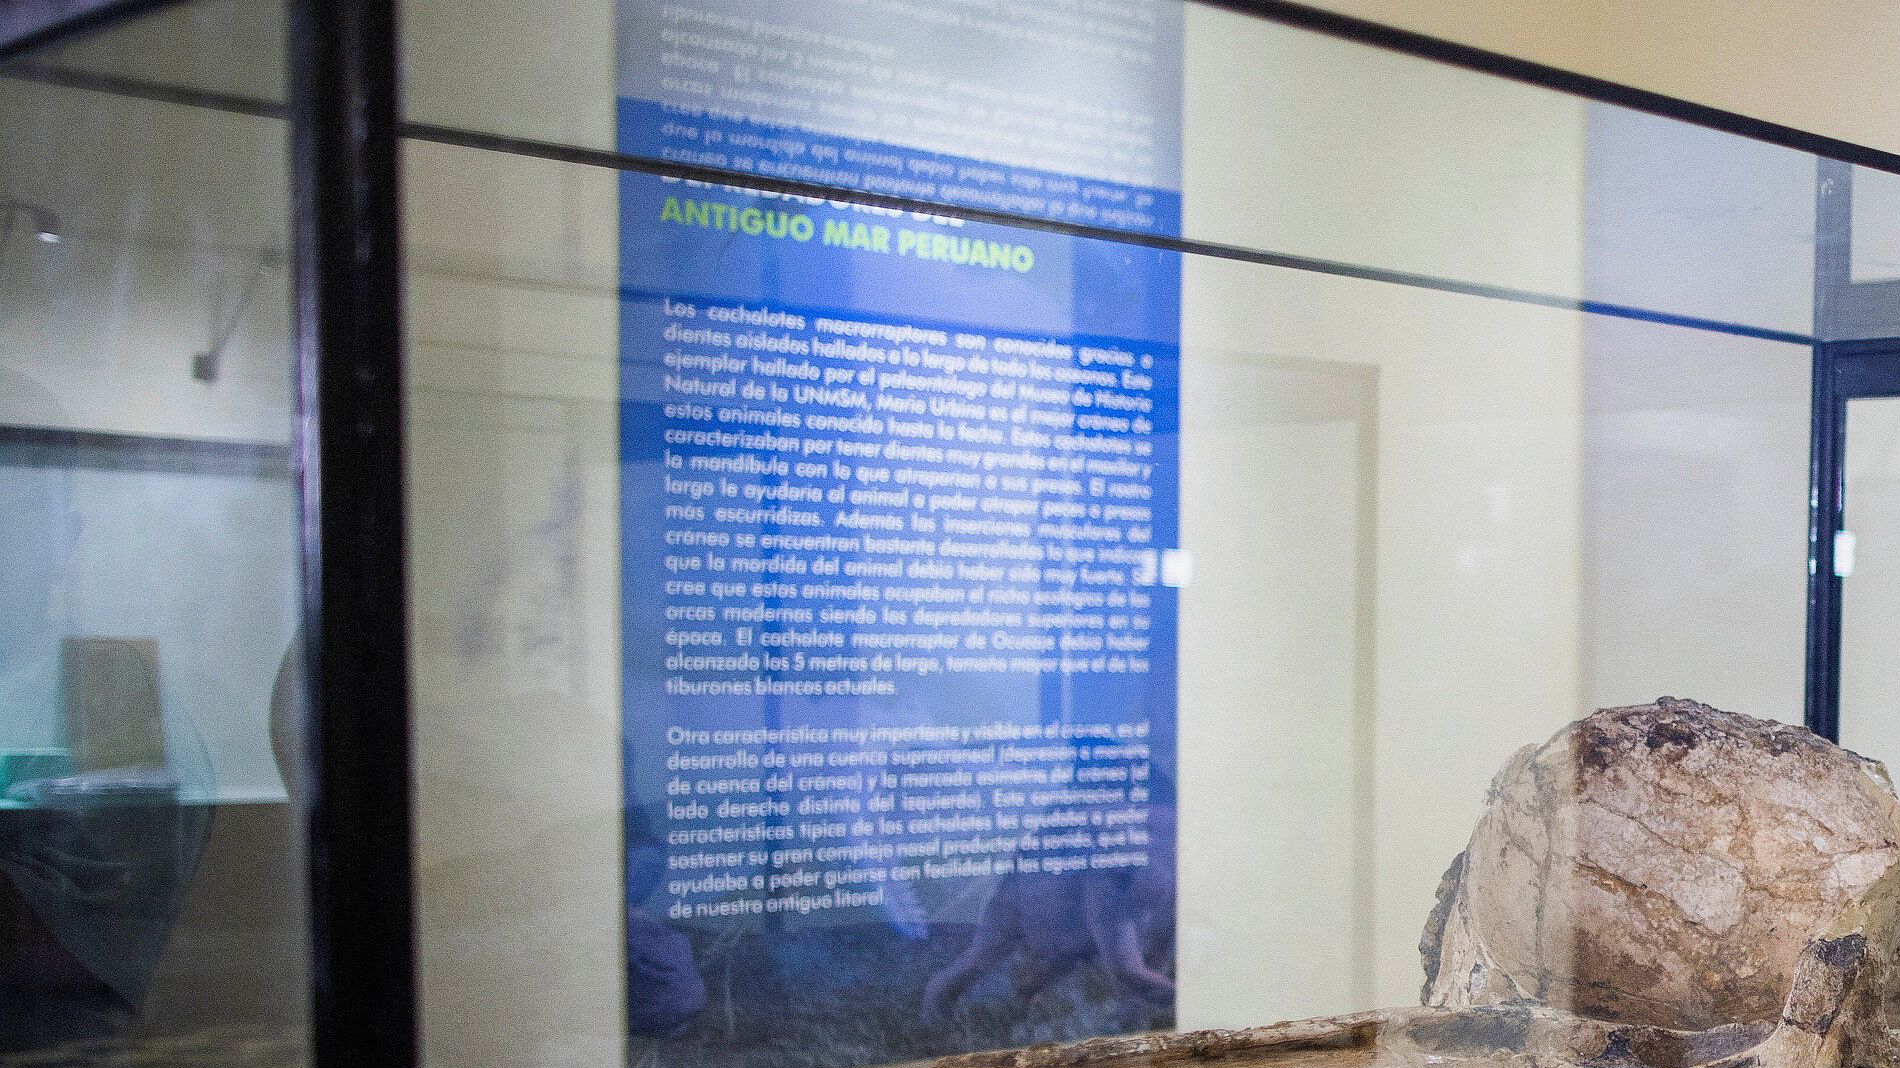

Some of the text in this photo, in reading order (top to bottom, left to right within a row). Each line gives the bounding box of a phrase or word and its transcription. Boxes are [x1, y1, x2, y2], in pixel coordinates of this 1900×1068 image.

[660, 197, 814, 242] ANTIGUO
[823, 219, 891, 254] MAR
[897, 229, 1034, 274] PERUANO
[664, 298, 696, 319] Los
[707, 306, 806, 331] cachalotes
[815, 318, 947, 346] macrorraptores
[664, 323, 732, 347] dientes
[736, 332, 809, 355] aislados
[813, 337, 885, 362] hallados
[664, 349, 747, 375] ejemplar
[752, 355, 820, 380] hallado
[824, 366, 855, 386] por
[858, 366, 874, 385] el
[664, 371, 735, 396] Natural
[742, 378, 765, 398] de
[771, 381, 788, 400] la
[664, 401, 712, 420] estos
[718, 405, 801, 427] animales
[806, 414, 883, 434] conocido
[888, 416, 933, 438] hasta
[664, 428, 799, 451] caracterizaban
[803, 437, 834, 456] por
[836, 436, 881, 457] tener
[665, 449, 682, 468] la
[796, 461, 827, 478] con
[833, 460, 851, 479] la
[856, 465, 889, 485] que
[665, 474, 714, 499] largo
[720, 477, 738, 497] le
[827, 484, 845, 503] al
[850, 487, 908, 506] animal
[735, 533, 755, 548] se
[760, 533, 860, 552] encuentran
[864, 534, 935, 555] bastante
[664, 554, 701, 573] que
[707, 551, 725, 570] la
[731, 553, 806, 573] mordida
[812, 555, 839, 574] del
[844, 558, 903, 576] animal
[665, 580, 705, 595] cree
[711, 581, 746, 600] que
[751, 580, 797, 598] estos
[802, 581, 879, 600] animales
[665, 605, 715, 620] orcas
[723, 603, 813, 622] modernas
[819, 605, 876, 624] siendo
[882, 605, 907, 624] los
[736, 627, 752, 646] El
[760, 628, 844, 647] cachalote
[665, 651, 760, 670] alcanzado
[764, 652, 789, 670] los
[794, 652, 805, 670] 5
[809, 653, 867, 671] metros
[871, 652, 892, 671] de
[665, 676, 751, 694] tiburones
[755, 676, 822, 694] blancos
[666, 726, 710, 744] Otra
[832, 726, 867, 745] muy
[666, 749, 758, 769] desarrollo
[762, 749, 785, 767] de
[790, 752, 823, 767] una
[828, 750, 887, 766] cuenca
[667, 776, 690, 794] de
[696, 777, 760, 794] cuenca
[765, 772, 793, 791] del
[867, 774, 877, 793] y
[881, 769, 897, 788] la
[667, 793, 894, 819] lado derecho distinto del
[852, 818, 873, 837] de
[879, 817, 903, 836] los
[668, 849, 745, 868] sostener
[748, 849, 768, 864] su
[771, 847, 812, 867] gran
[816, 840, 894, 863] complejo
[668, 871, 747, 897] ayudaba
[752, 874, 764, 888] a
[769, 867, 820, 892] poder
[824, 866, 886, 889] guiarse
[890, 865, 920, 880] con
[669, 899, 692, 918] de
[696, 896, 763, 916] nuestro
[766, 892, 832, 914] antiguo
